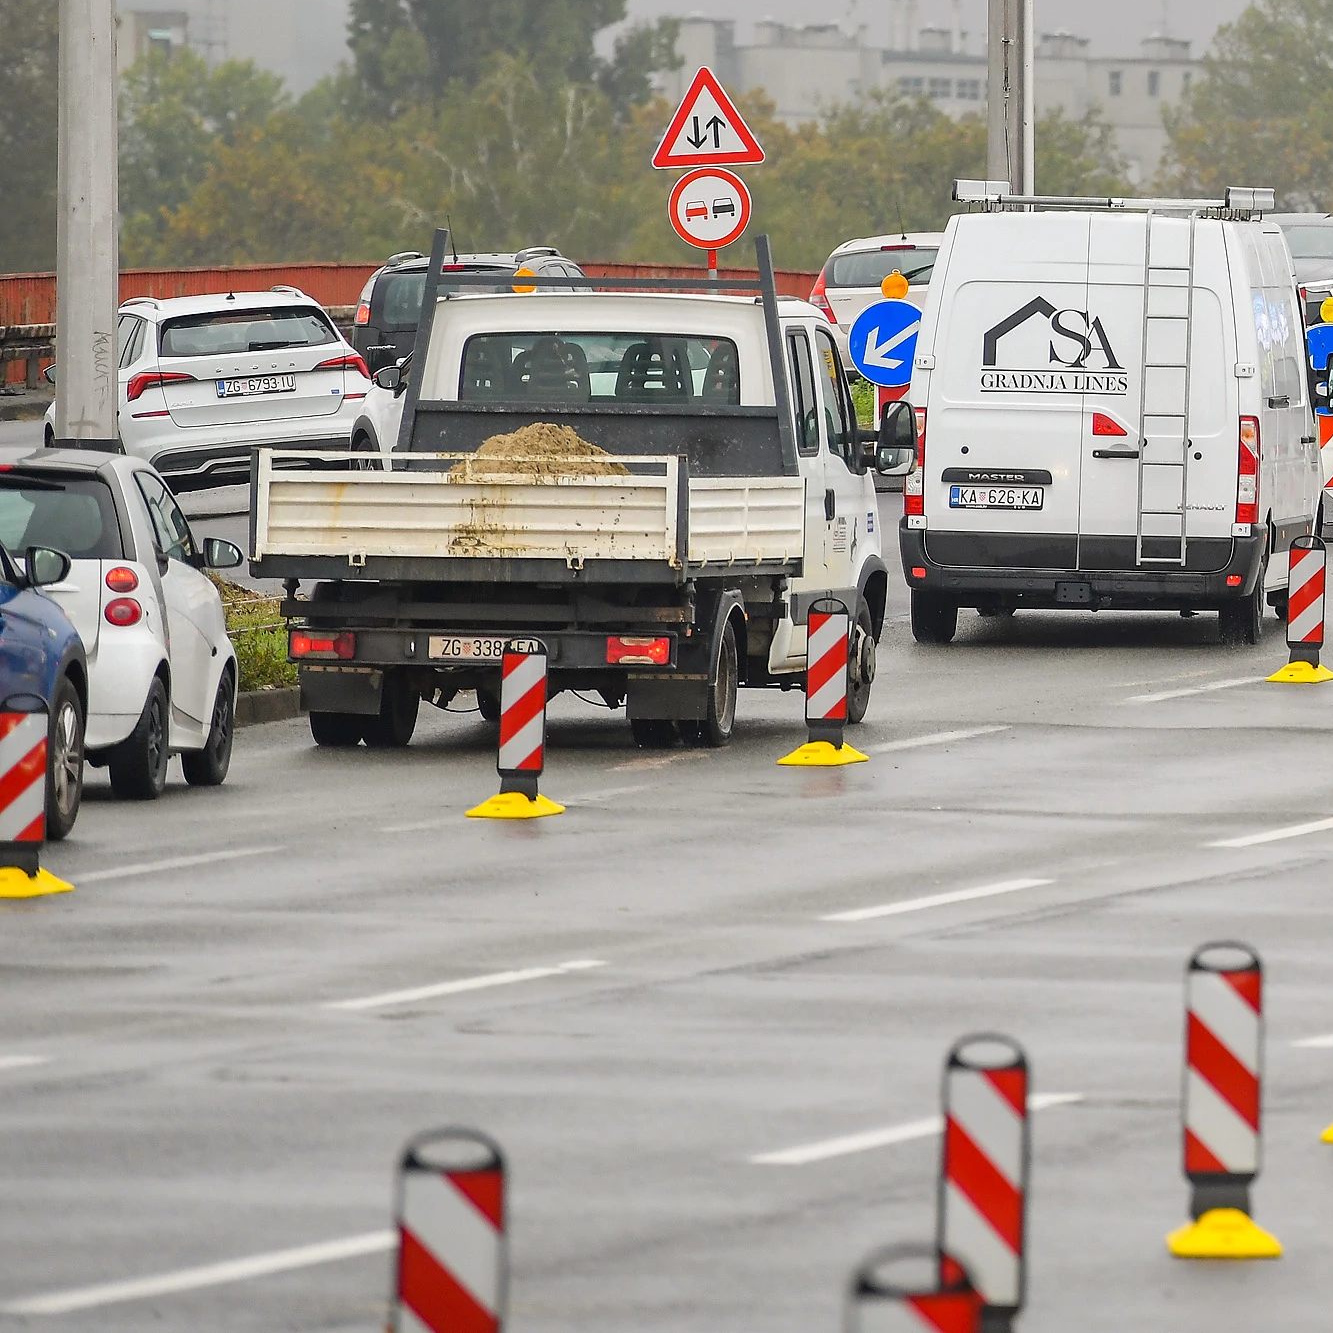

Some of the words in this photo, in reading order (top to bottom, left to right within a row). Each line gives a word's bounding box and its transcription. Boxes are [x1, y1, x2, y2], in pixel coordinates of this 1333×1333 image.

[225, 380, 241, 393] ZG
[980, 373, 1067, 390] GRADNJA
[1073, 375, 1128, 392] LINES
[968, 473, 1025, 482] MASTER
[960, 489, 977, 504] KA
[441, 639, 461, 657] ZG
